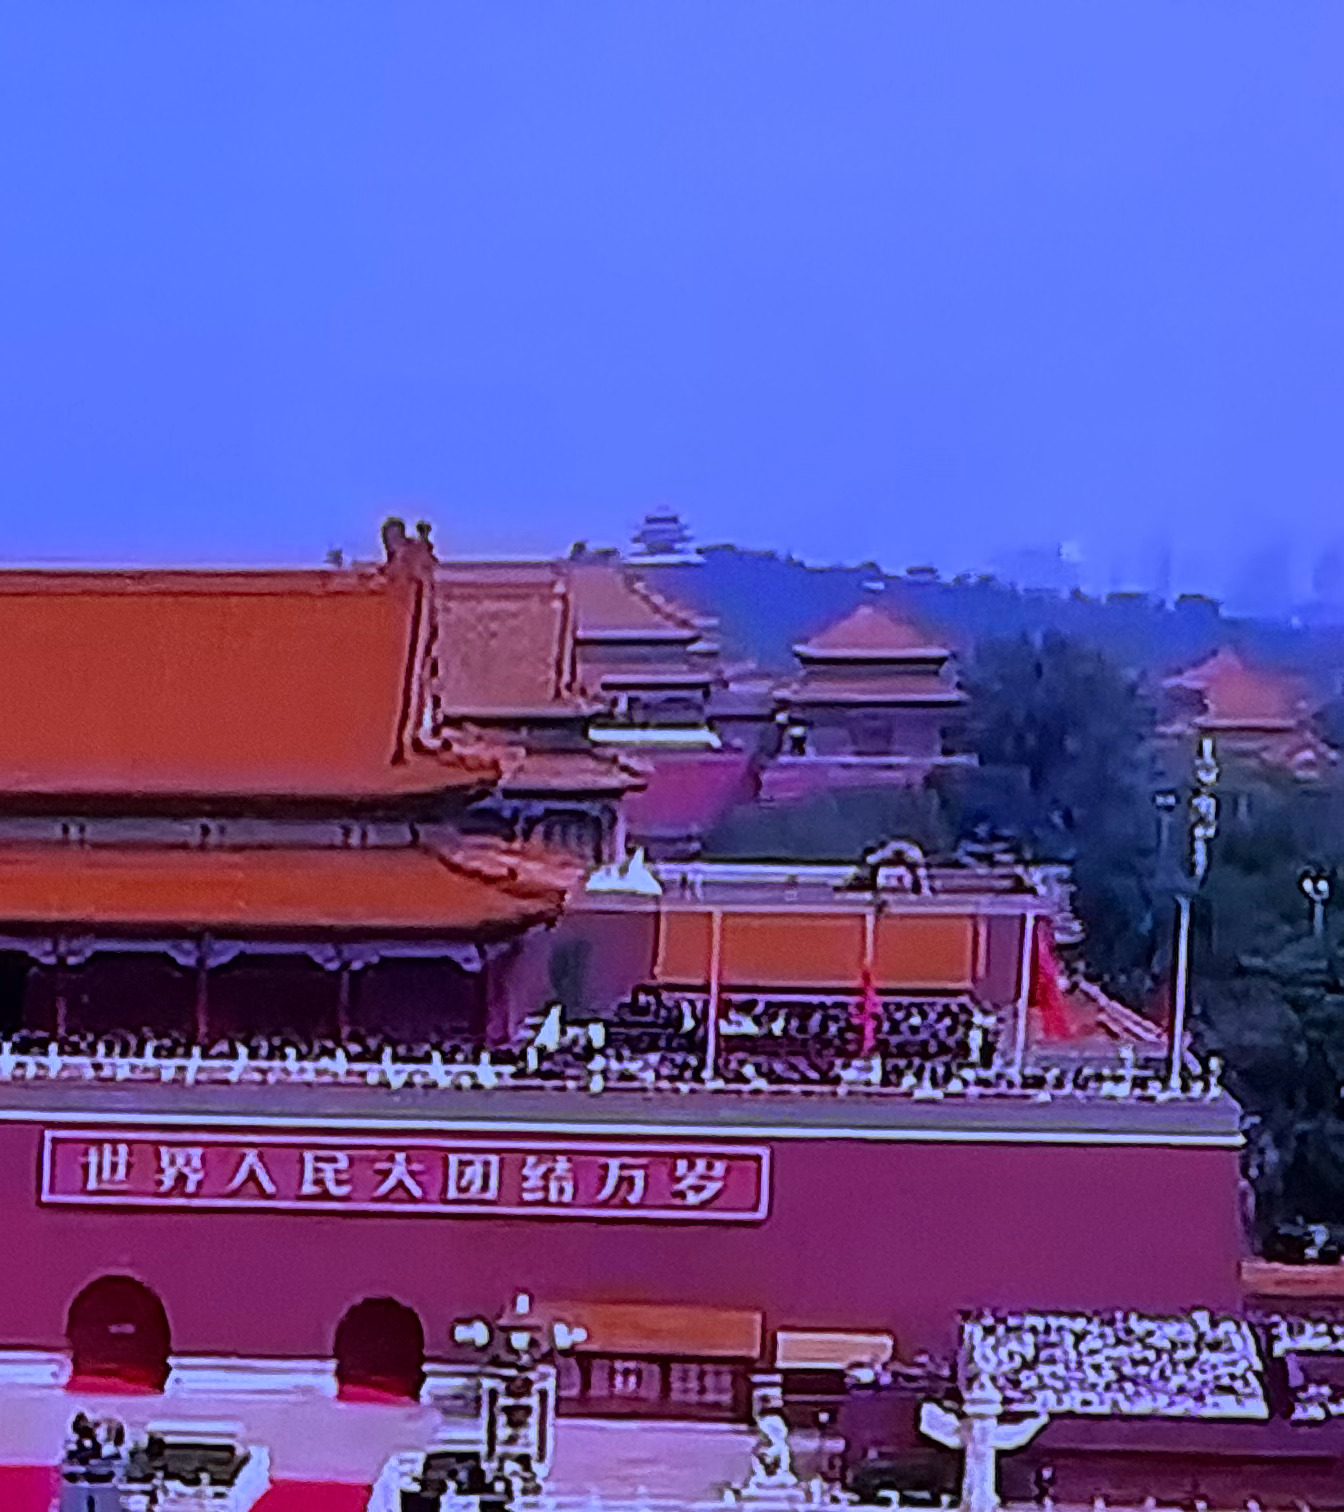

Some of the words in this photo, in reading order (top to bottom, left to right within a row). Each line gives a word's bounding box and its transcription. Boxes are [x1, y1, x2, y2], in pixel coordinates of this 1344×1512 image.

[79, 1142, 729, 1206] 世界人民大团结万岁
